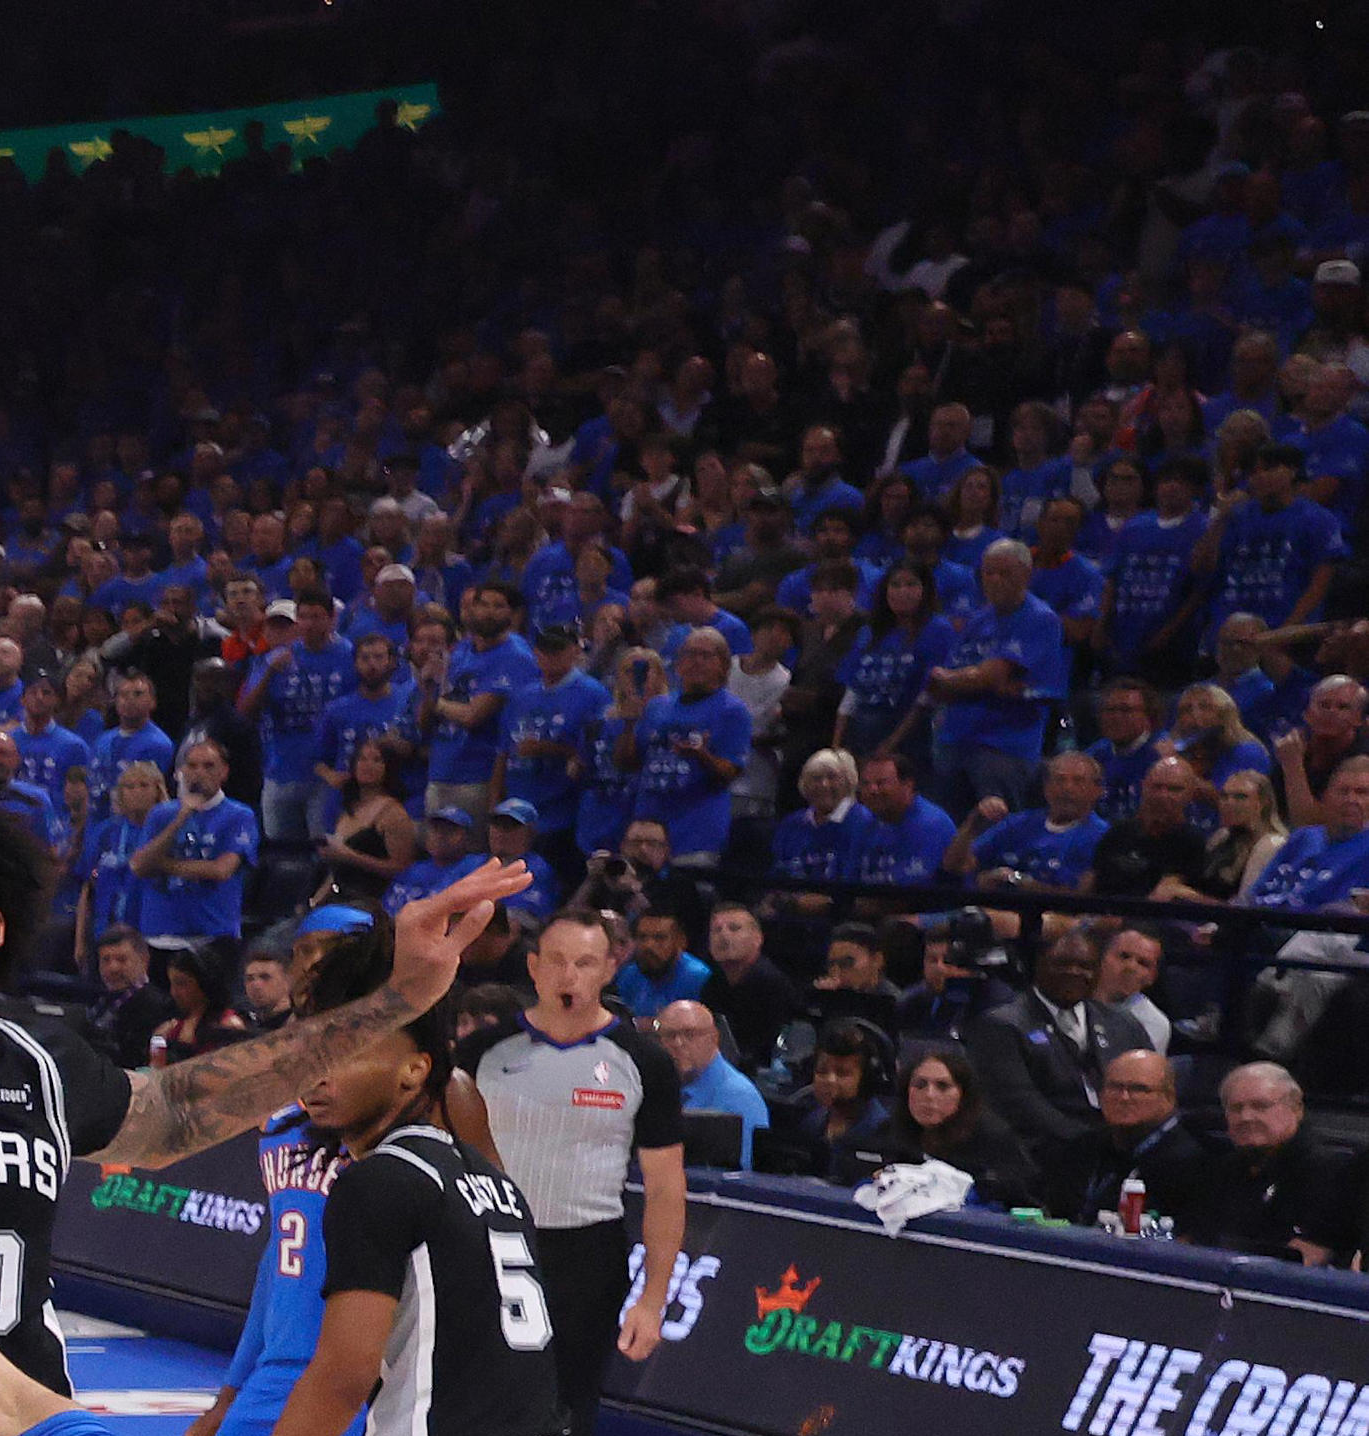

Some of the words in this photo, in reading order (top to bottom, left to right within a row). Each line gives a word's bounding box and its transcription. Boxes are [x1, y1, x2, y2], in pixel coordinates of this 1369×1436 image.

[278, 1209, 307, 1278] 2
[488, 1226, 554, 1352] 5
[745, 1307, 1026, 1399] DRAFTKINGS
